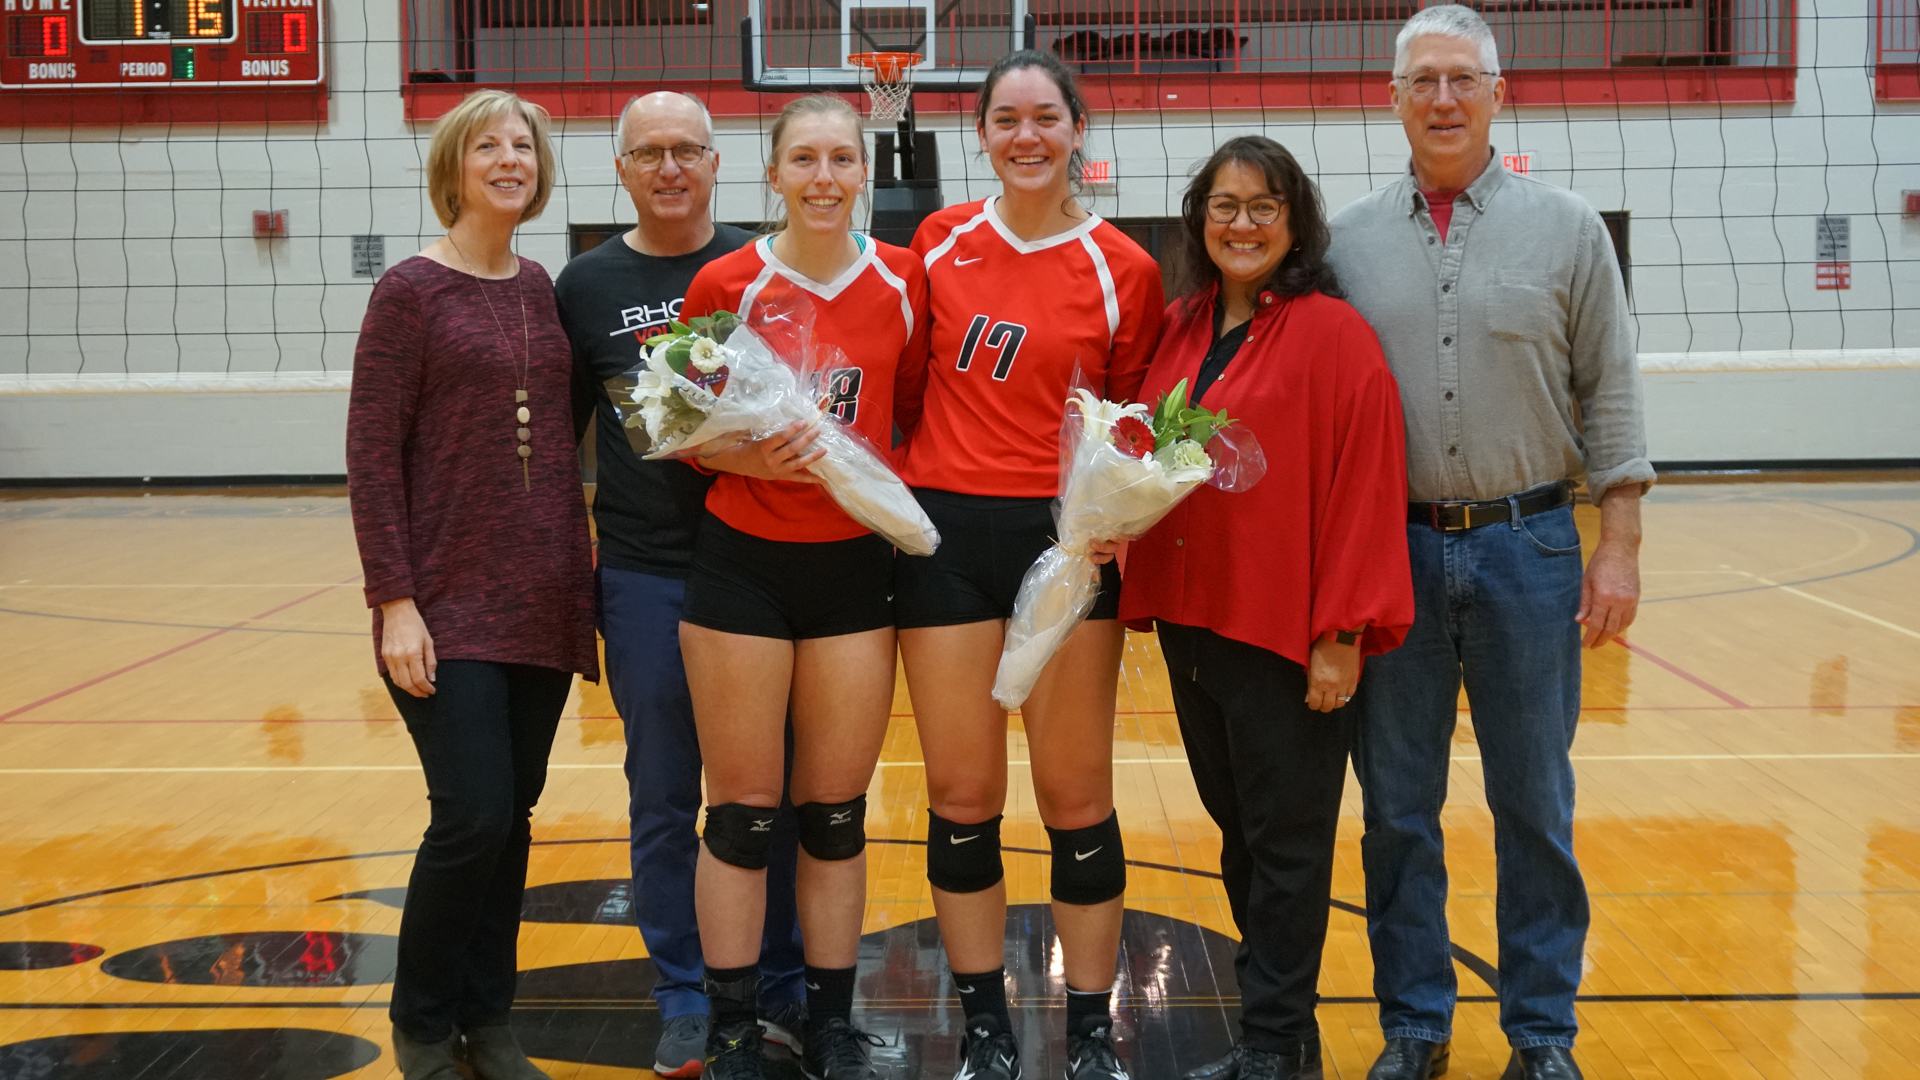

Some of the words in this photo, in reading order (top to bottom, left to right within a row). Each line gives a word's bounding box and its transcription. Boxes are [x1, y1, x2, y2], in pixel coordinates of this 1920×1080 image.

[4, 0, 71, 11] HOME
[43, 16, 67, 56] 0
[283, 12, 307, 53] 0
[28, 62, 77, 79] BONUS
[120, 62, 167, 76] PERIOD
[241, 59, 289, 76] BONUS
[1084, 161, 1109, 182] EXIT
[1503, 155, 1529, 175] EXIT
[956, 314, 1027, 382] 17
